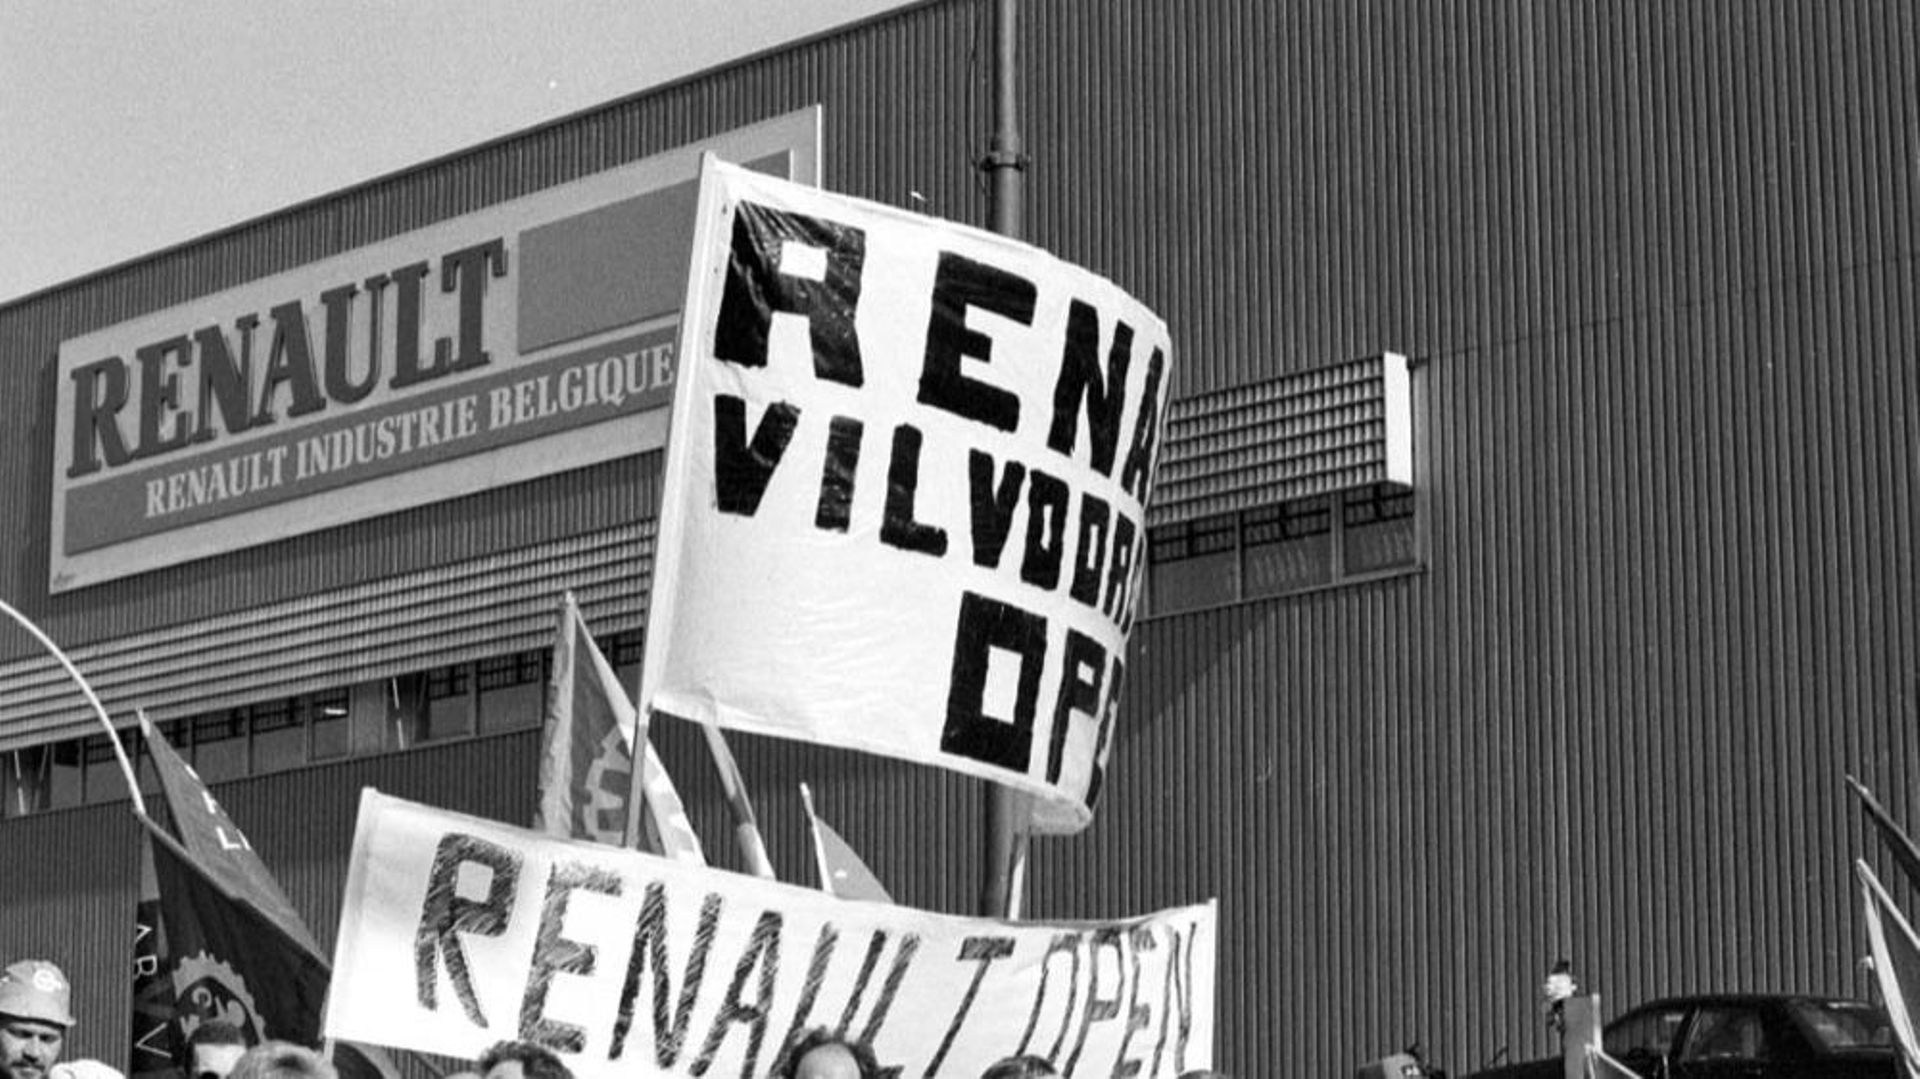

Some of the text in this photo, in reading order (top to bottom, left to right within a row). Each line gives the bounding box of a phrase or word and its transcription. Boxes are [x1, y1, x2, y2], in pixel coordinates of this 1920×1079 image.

[67, 238, 508, 478] RENAULT
[146, 343, 674, 518] RENAULT INDUSTRIE BELGIQUE
[714, 199, 1165, 510] RENA
[415, 832, 1196, 1079] RENAULT OPEN
